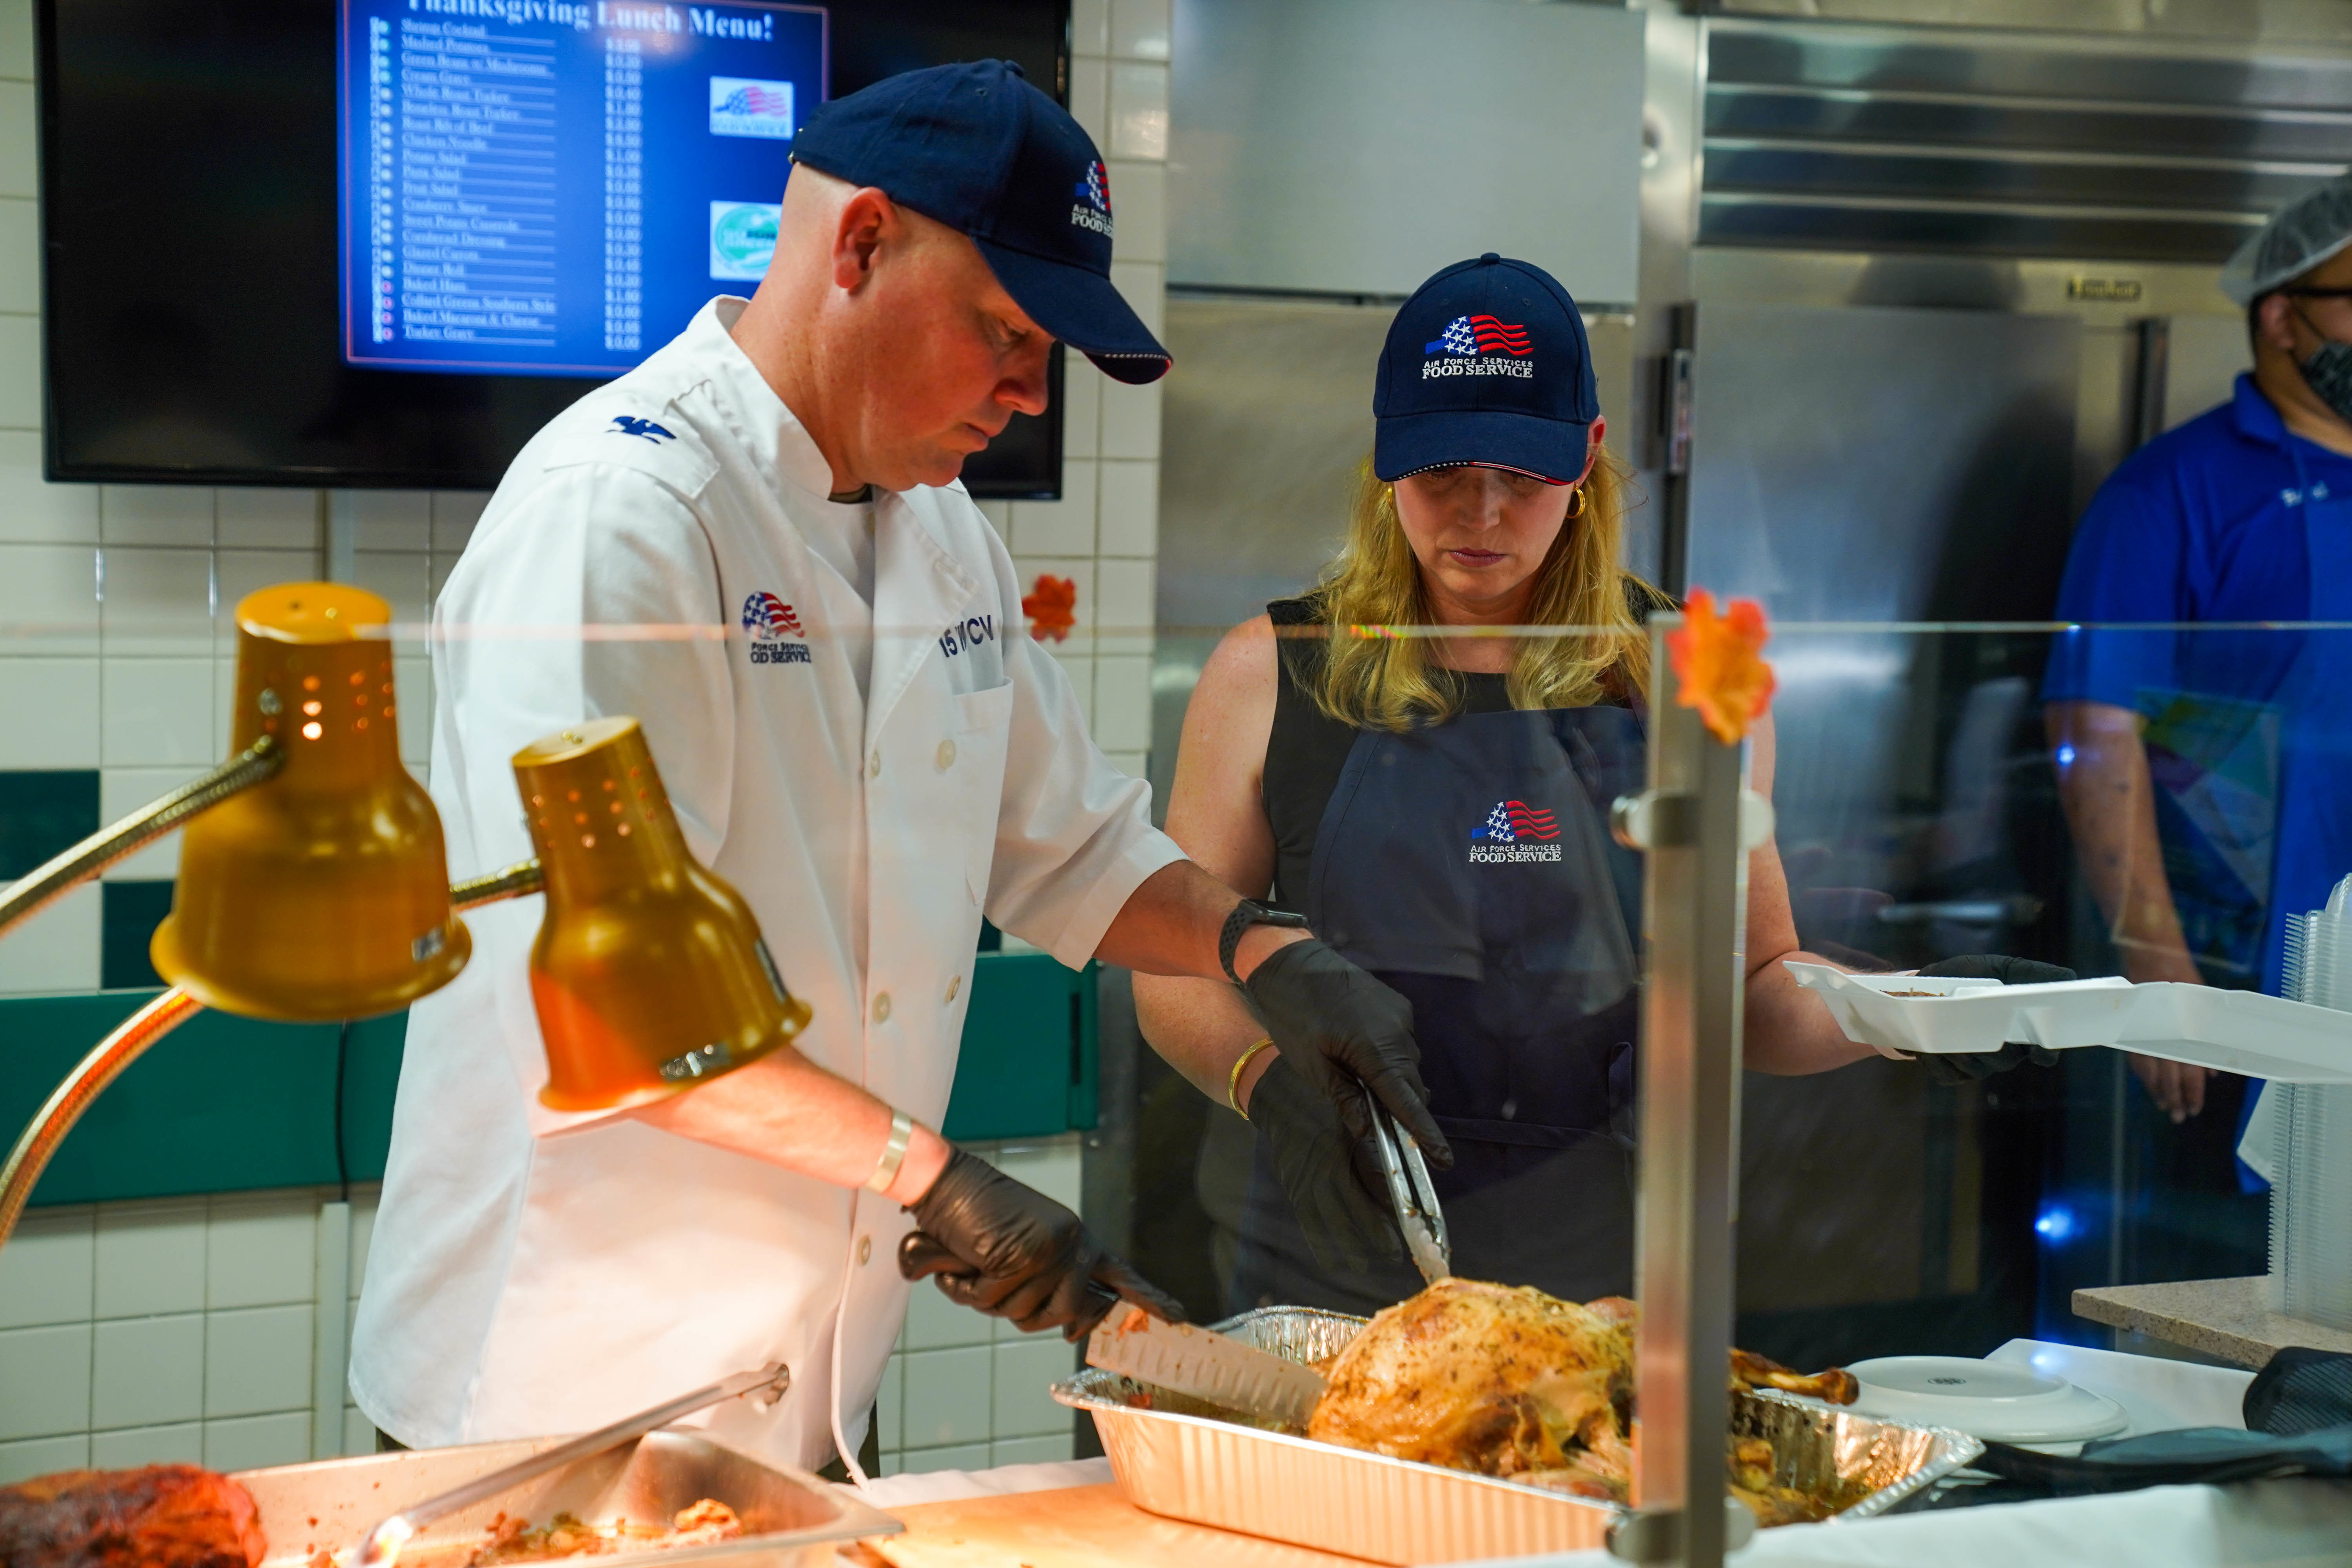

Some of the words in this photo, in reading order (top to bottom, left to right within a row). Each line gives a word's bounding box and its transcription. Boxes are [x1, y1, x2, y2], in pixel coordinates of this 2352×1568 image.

[597, 0, 682, 33] Lunch
[688, 7, 773, 41] Menu!
[1483, 358, 1533, 367] SERVICES
[939, 629, 958, 658] 15
